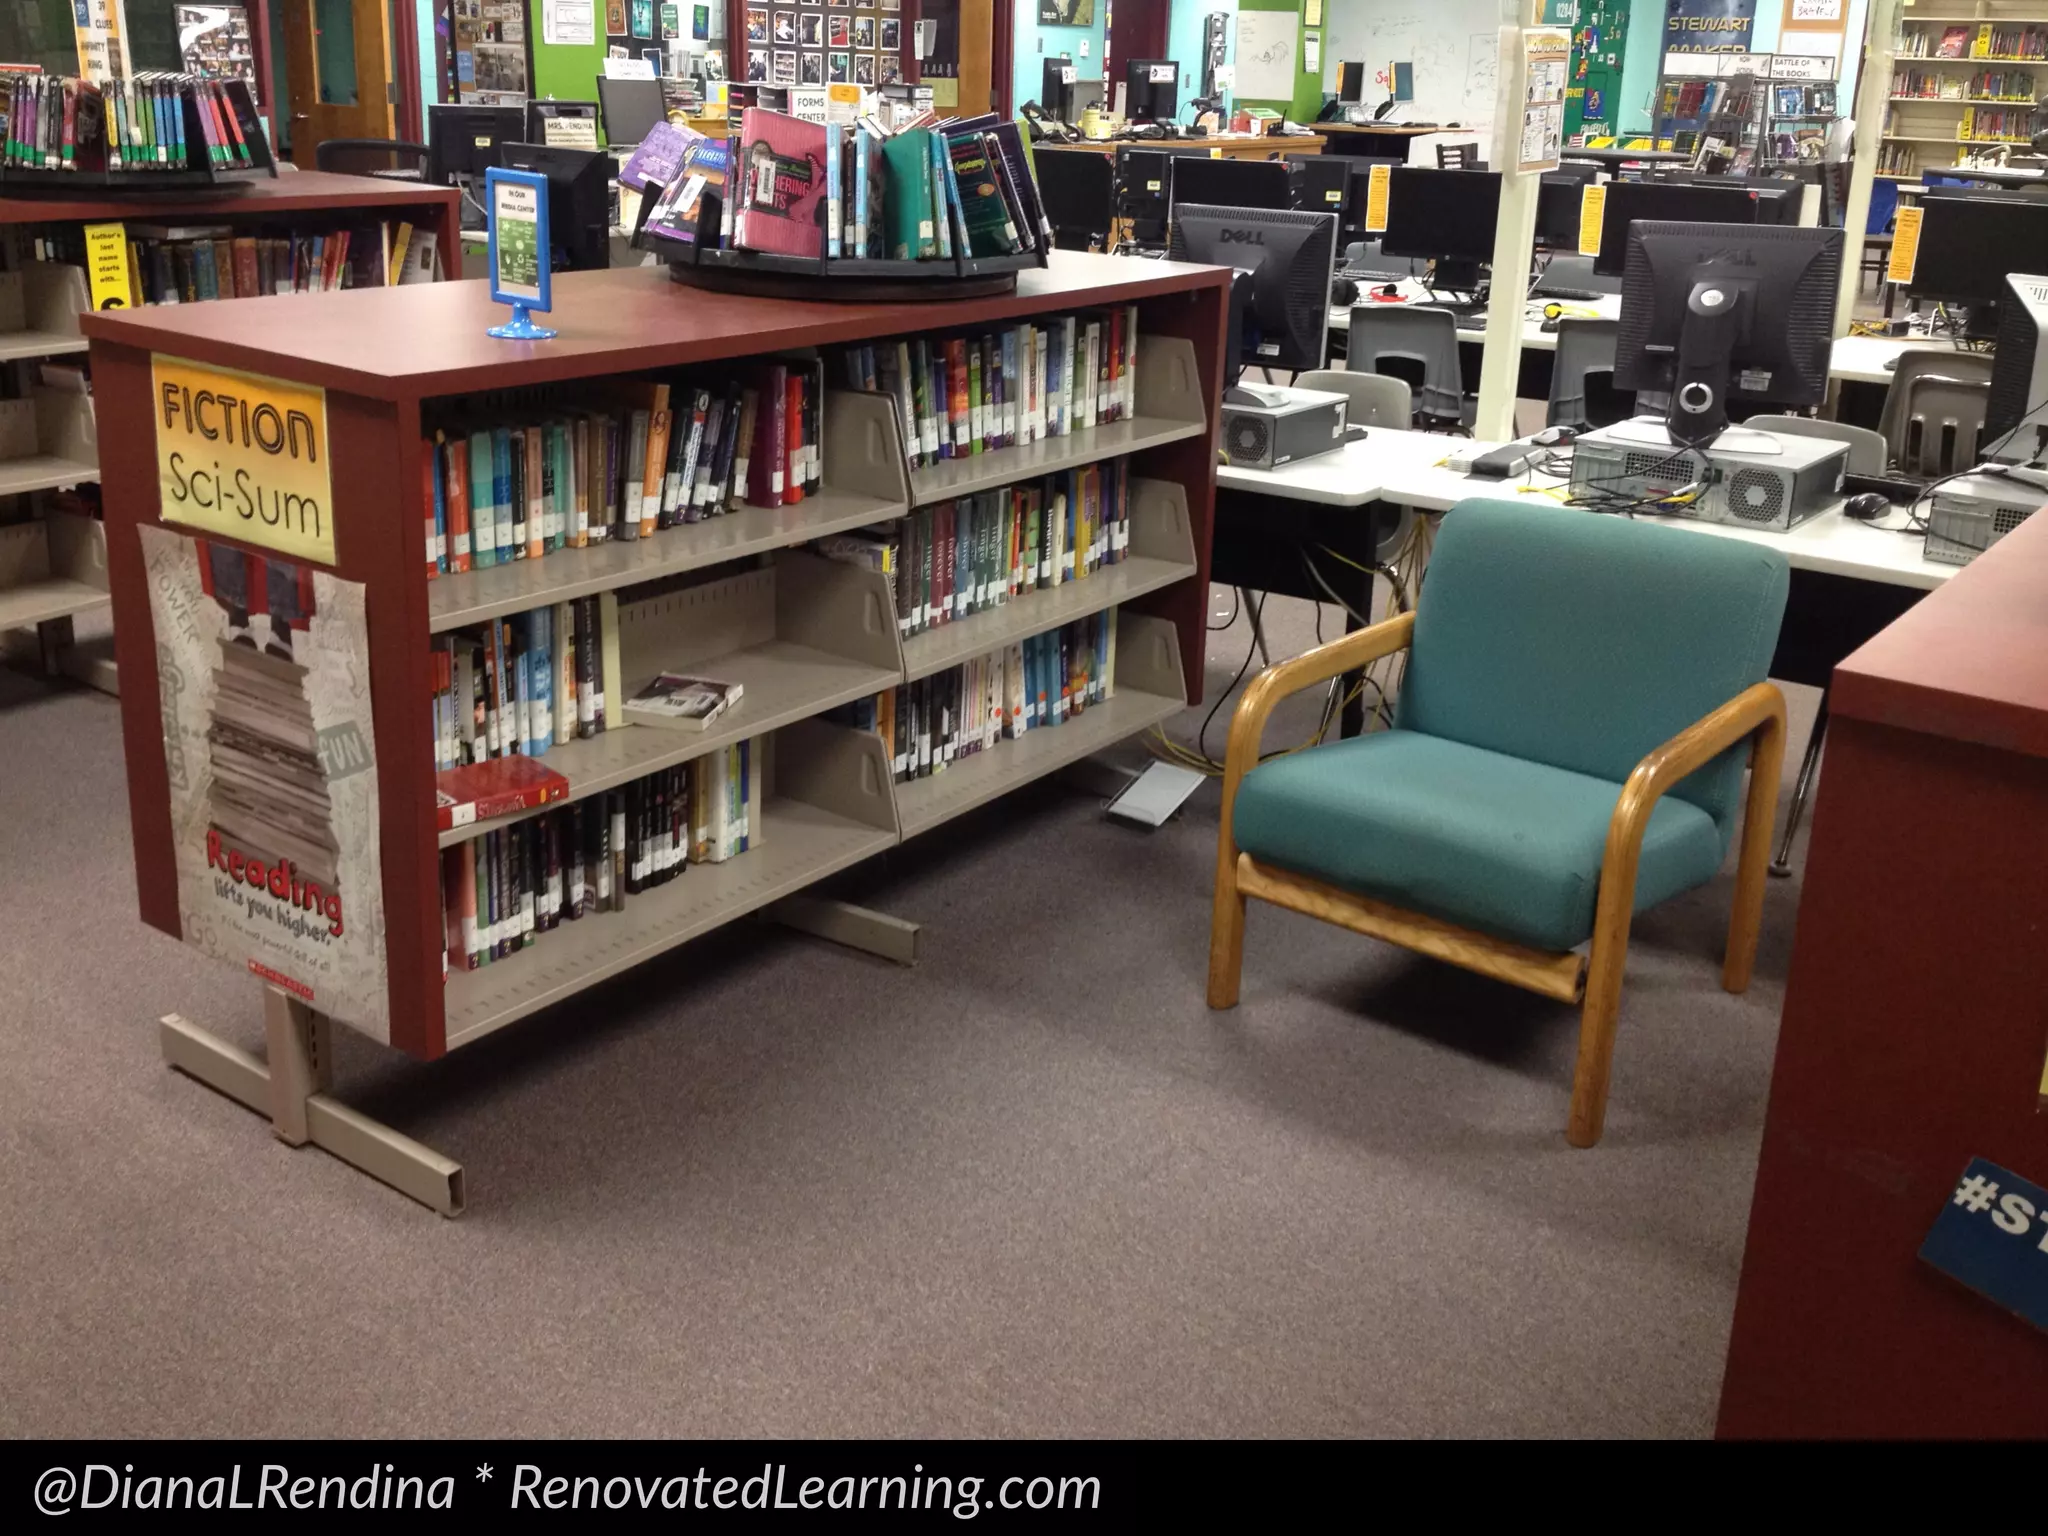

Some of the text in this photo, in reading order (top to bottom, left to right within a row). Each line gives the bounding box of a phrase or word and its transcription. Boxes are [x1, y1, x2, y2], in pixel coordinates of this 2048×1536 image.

[96, 20, 113, 29] CLUES
[1668, 17, 1750, 31] STEWART
[1774, 59, 1799, 67] BATTLE
[1772, 69, 1811, 78] THE BOOKS
[797, 98, 825, 107] FORMS
[796, 113, 826, 122] CENTER
[547, 122, 563, 130] MRS.
[517, 205, 535, 213] CENTER
[91, 232, 121, 241] Author's
[1220, 228, 1265, 246] DELL
[99, 265, 120, 273] starts
[162, 382, 316, 464] FICTION
[169, 452, 320, 538] Sci-Sum
[207, 830, 344, 938] Reading
[214, 876, 244, 906] lifts
[246, 896, 273, 919] you
[1953, 1174, 2048, 1254] #S
